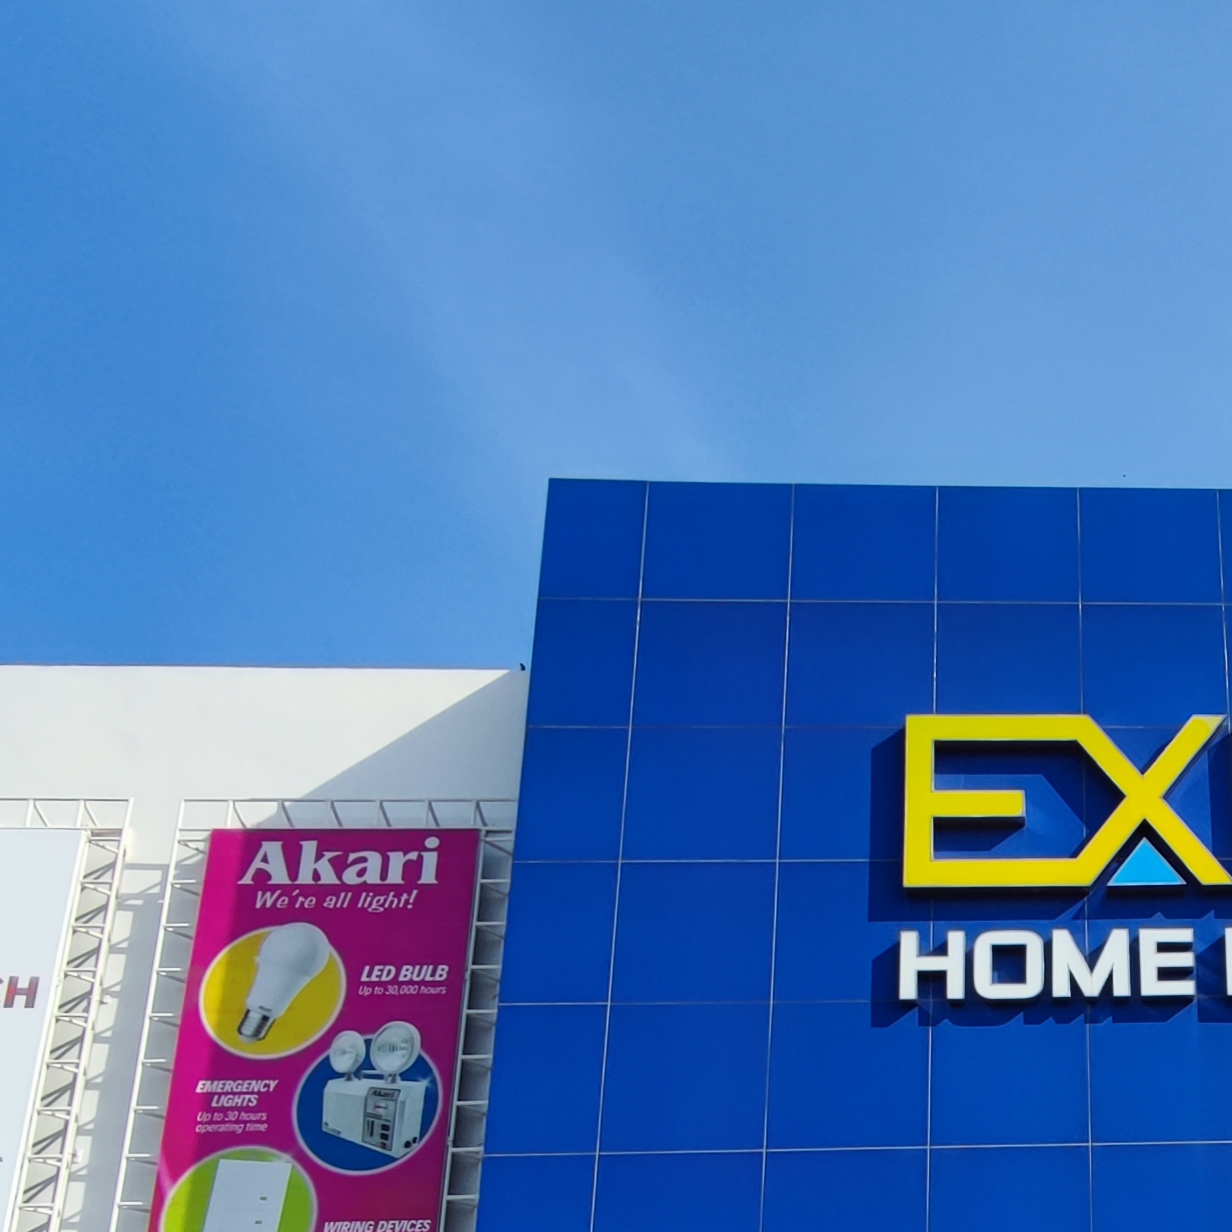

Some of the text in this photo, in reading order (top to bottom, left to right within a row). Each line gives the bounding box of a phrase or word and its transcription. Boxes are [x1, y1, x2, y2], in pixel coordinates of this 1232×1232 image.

[237, 836, 440, 885] Akari
[255, 889, 419, 912] We're all light!
[899, 927, 1196, 1000] HOME
[360, 964, 449, 982] LED BULB
[358, 985, 447, 996] Up to 30,000 hours
[195, 1079, 279, 1093] EMERGENCY
[211, 1094, 259, 1108] LIGHTS
[196, 1111, 267, 1123] Up to 30 hours
[196, 1122, 268, 1134] operating time
[376, 1219, 432, 1232] DEVICES
